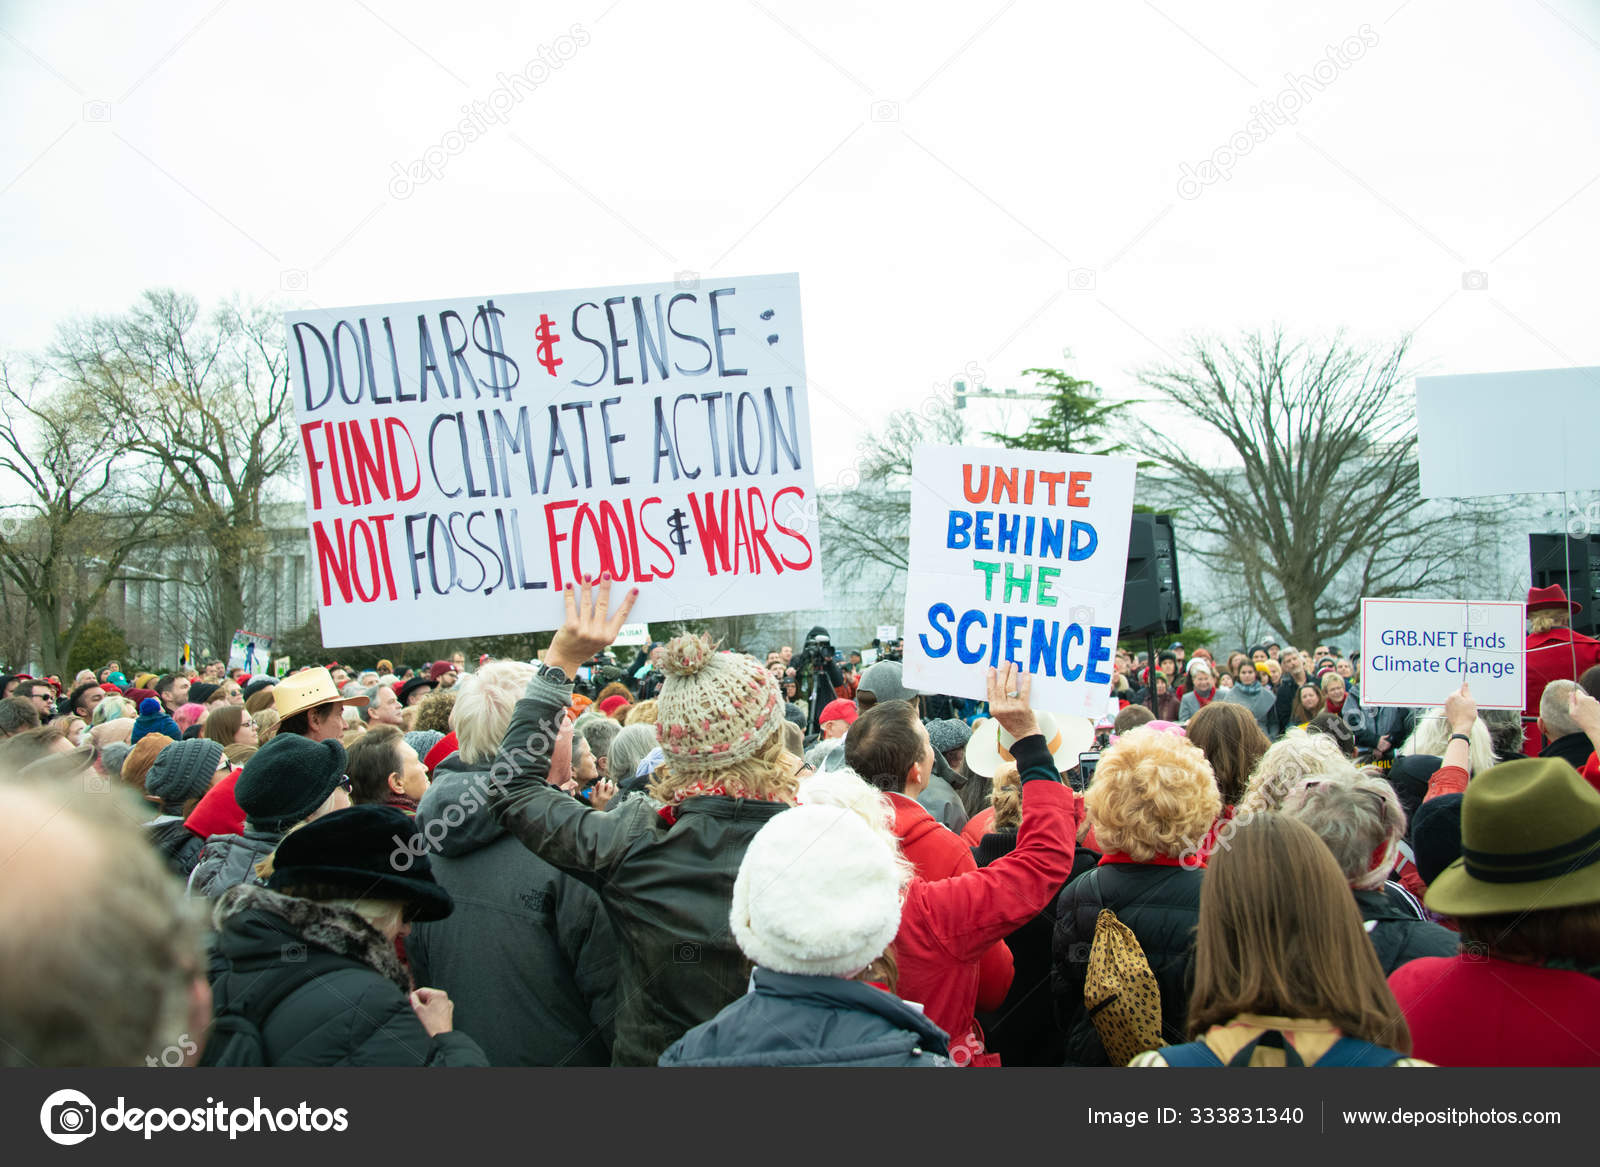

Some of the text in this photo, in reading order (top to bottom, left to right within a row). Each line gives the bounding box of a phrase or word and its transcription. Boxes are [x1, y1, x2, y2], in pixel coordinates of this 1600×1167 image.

[301, 416, 421, 510] FUND
[429, 396, 630, 498] CLIMATE
[653, 385, 802, 483] ACTION
[962, 463, 1092, 507] UNITE
[313, 513, 398, 606] NOT
[404, 508, 548, 600] FOSSIL
[544, 496, 675, 592] FOOLS
[688, 486, 813, 575] WARS
[947, 510, 1098, 561] BEHIND
[973, 559, 1061, 607] THE
[918, 602, 1112, 684] SCIENCE
[1381, 629, 1506, 649] GRB.NET Ends
[1372, 654, 1515, 679] Climate Change
